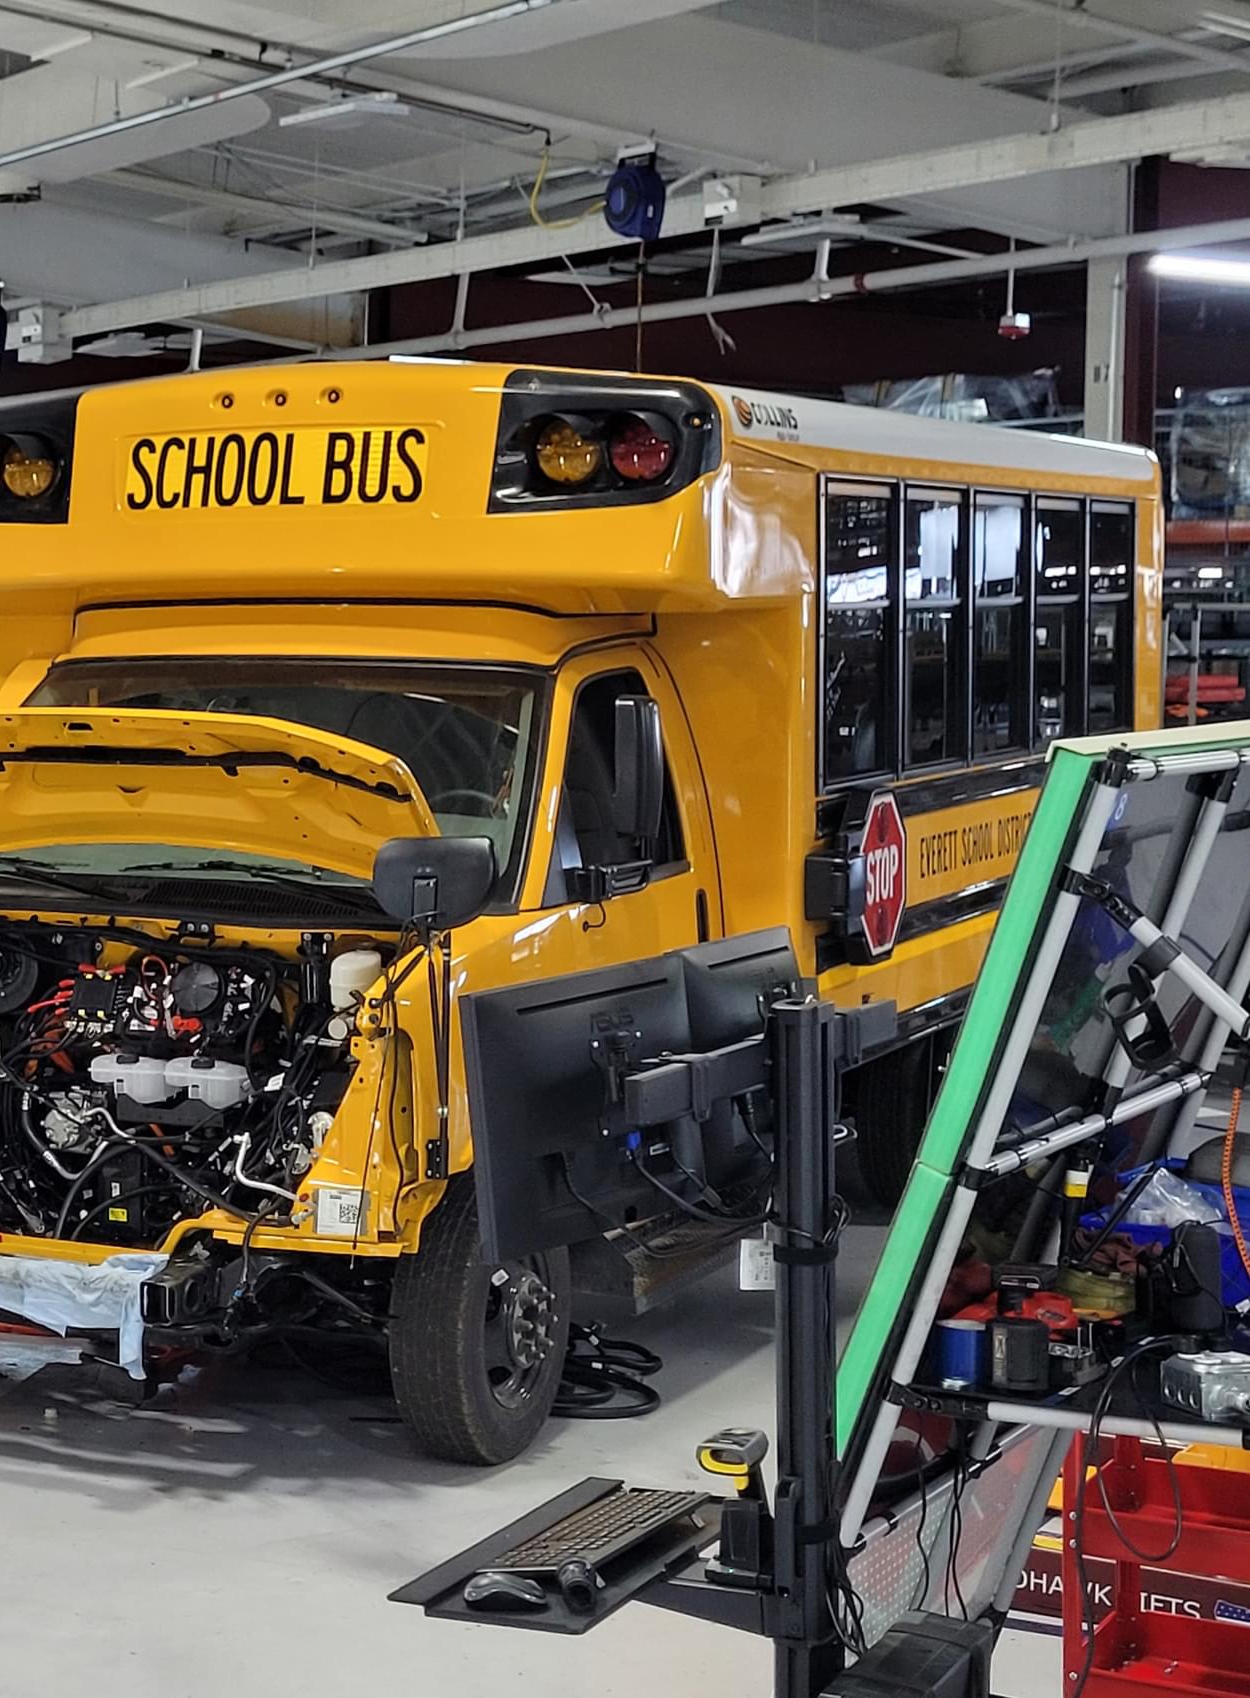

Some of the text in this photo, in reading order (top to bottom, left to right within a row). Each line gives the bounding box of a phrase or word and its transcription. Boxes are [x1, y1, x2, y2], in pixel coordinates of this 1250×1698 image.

[127, 428, 426, 510] SCHOOL BUS
[866, 844, 899, 906] STOP
[920, 811, 1031, 879] EVERETT SCHOOL DISTRIC
